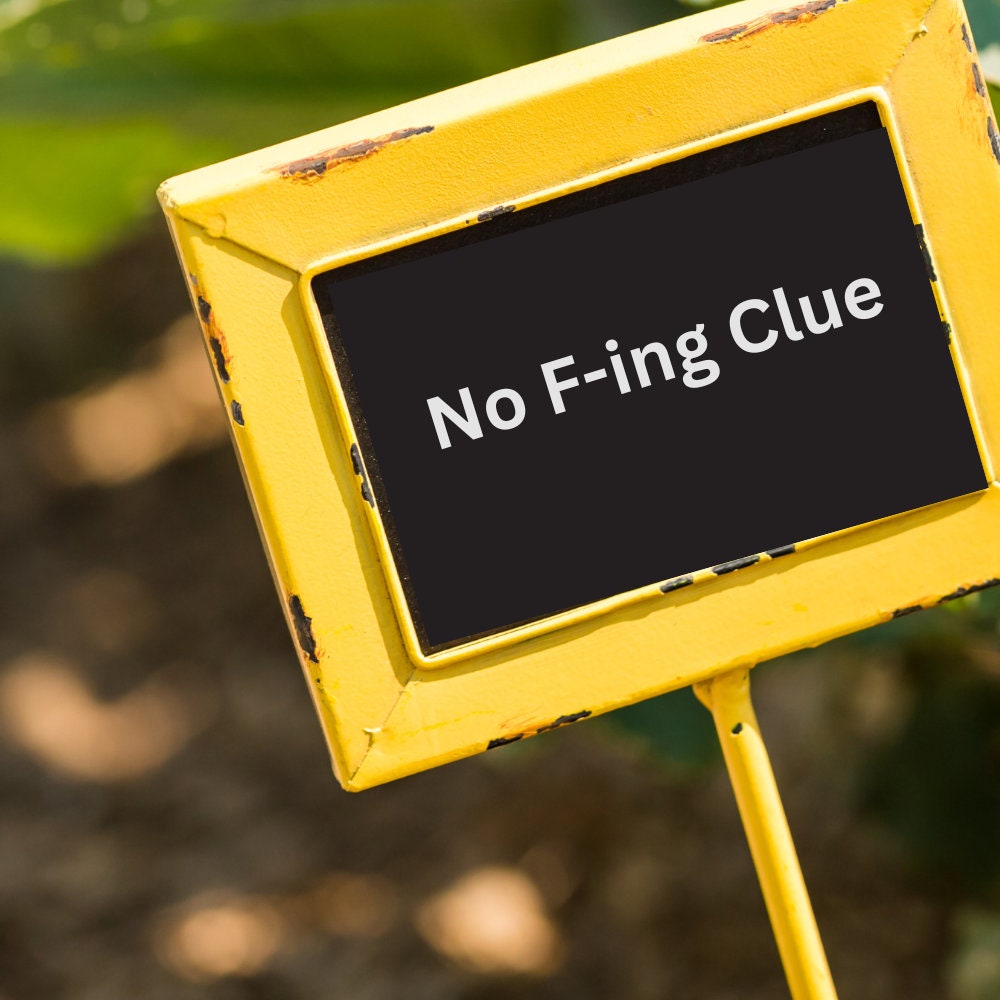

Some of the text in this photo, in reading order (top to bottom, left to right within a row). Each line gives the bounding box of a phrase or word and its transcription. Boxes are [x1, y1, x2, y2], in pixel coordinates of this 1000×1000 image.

[426, 277, 884, 450] No F-ing Clue
